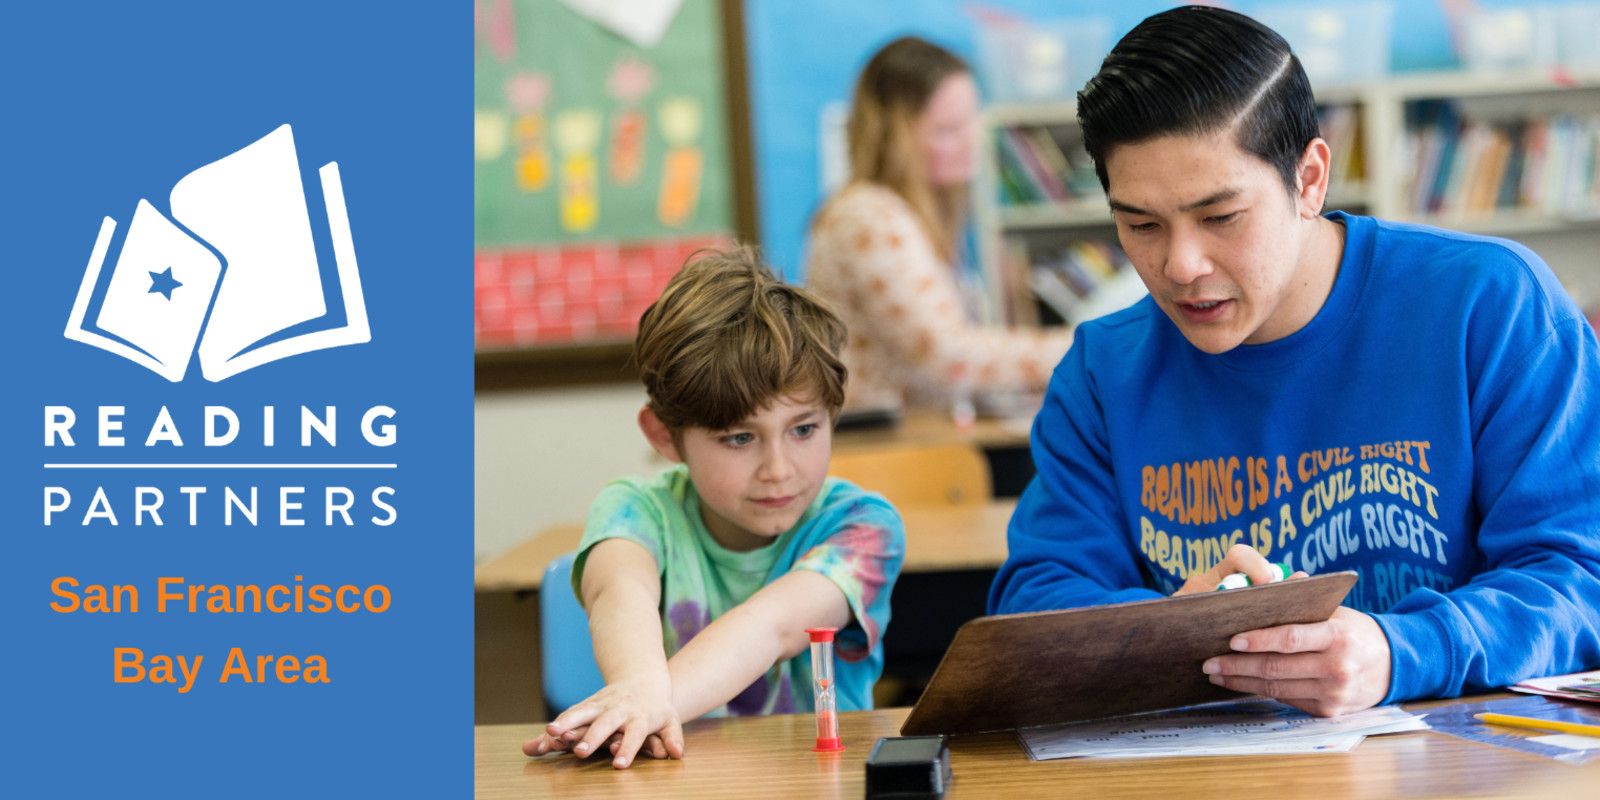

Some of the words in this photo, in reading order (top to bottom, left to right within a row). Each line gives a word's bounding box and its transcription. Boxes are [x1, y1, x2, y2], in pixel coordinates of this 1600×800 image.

[1247, 456, 1270, 512] IS
[1274, 455, 1293, 499] A
[1298, 447, 1355, 483] CIVIL
[1360, 440, 1431, 474] RIGHT
[1251, 517, 1273, 558] IS
[1278, 503, 1297, 549] A
[1301, 468, 1356, 527] CIVIL
[1360, 462, 1439, 520] RIGHT
[1301, 508, 1360, 575] CIVIL
[1361, 502, 1448, 566] RIGHT
